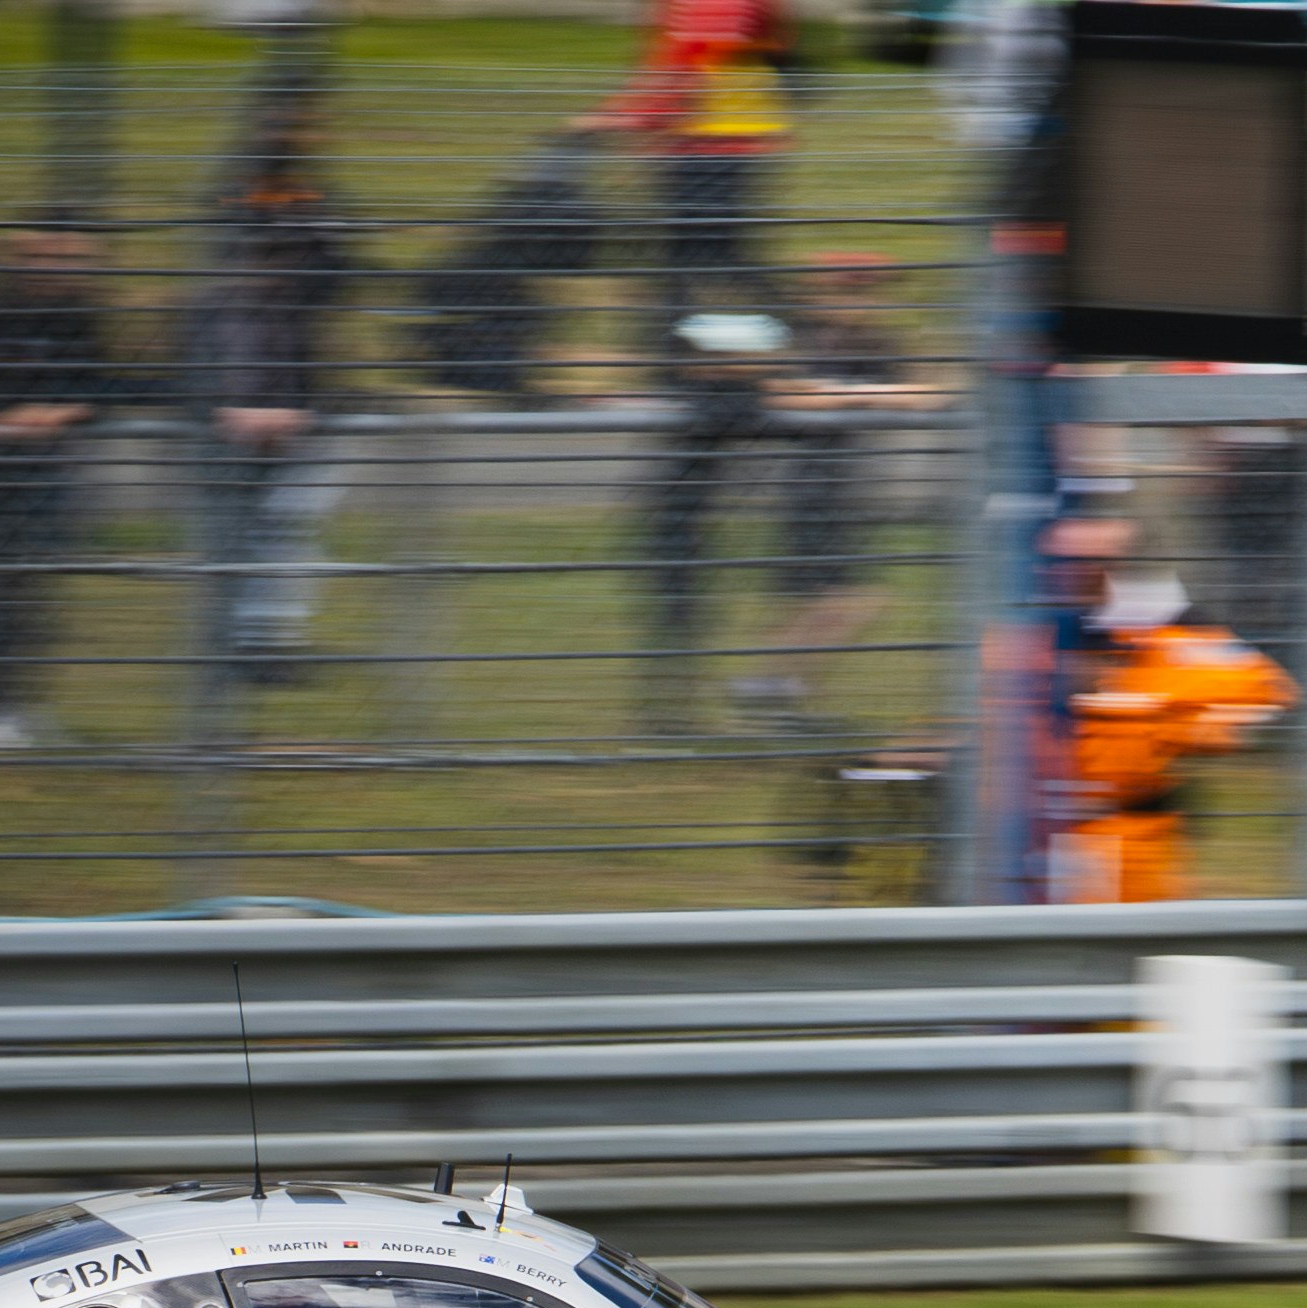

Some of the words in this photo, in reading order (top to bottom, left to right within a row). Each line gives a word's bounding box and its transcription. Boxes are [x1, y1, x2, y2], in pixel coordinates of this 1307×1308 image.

[268, 1241, 328, 1252] MARTIN
[381, 1242, 457, 1257] ANDRADE
[75, 1248, 152, 1288] BAI
[516, 1264, 567, 1287] BERRY
